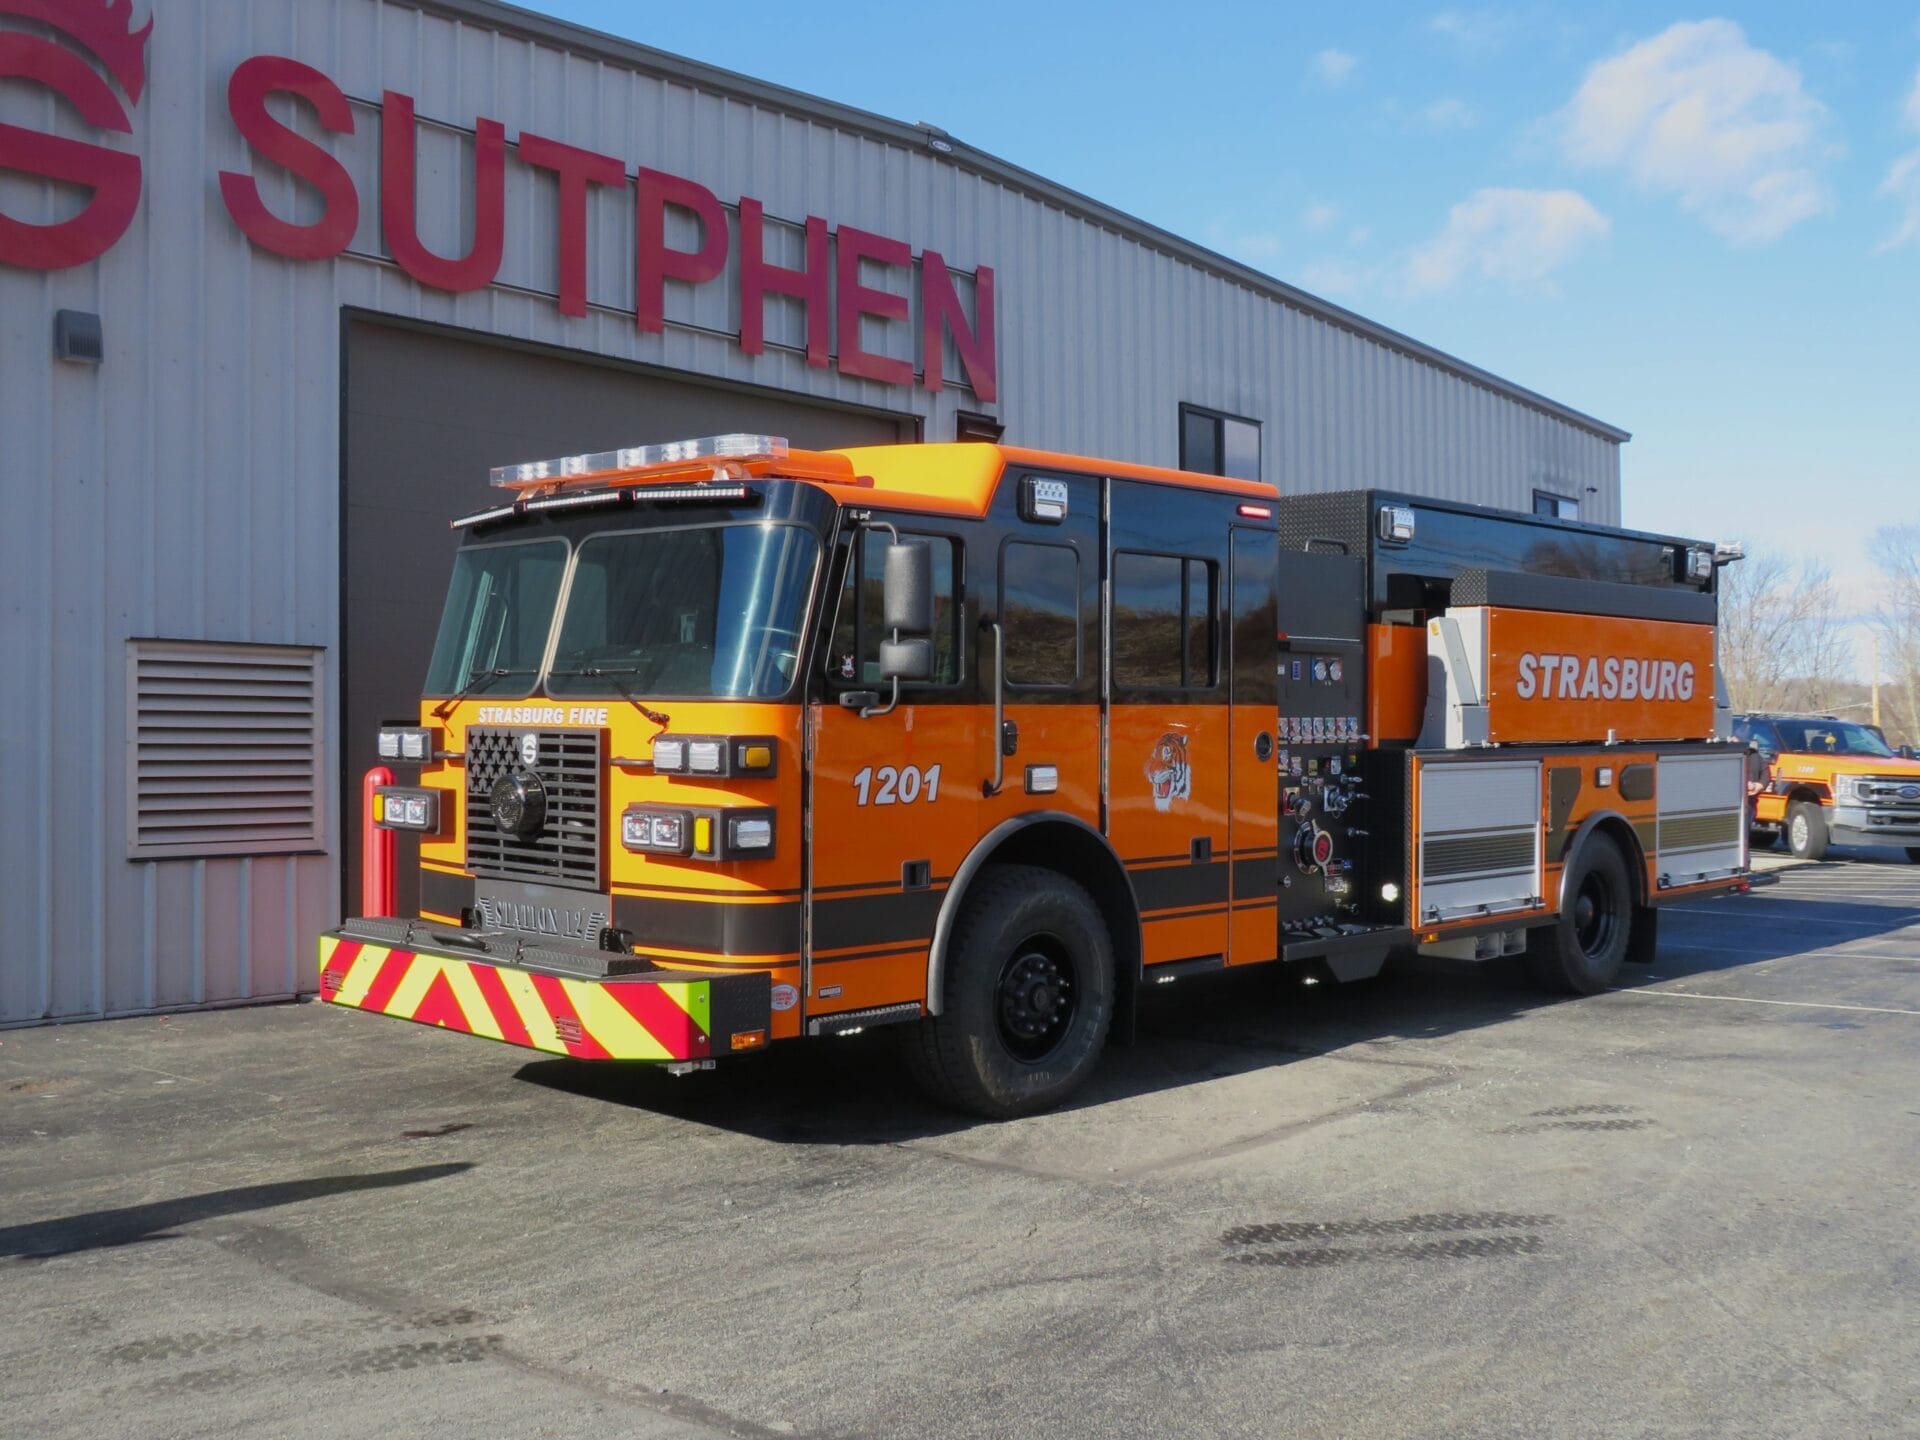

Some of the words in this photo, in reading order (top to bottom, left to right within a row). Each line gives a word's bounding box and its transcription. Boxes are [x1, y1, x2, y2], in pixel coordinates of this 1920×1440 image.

[219, 54, 996, 403] SUTPHEN
[1516, 652, 1694, 700] STRASBURG
[479, 706, 564, 724] STRASBURG
[568, 707, 608, 725] FIRE
[853, 764, 942, 806] 1201
[494, 901, 558, 934] STATION
[563, 909, 583, 937] 12
